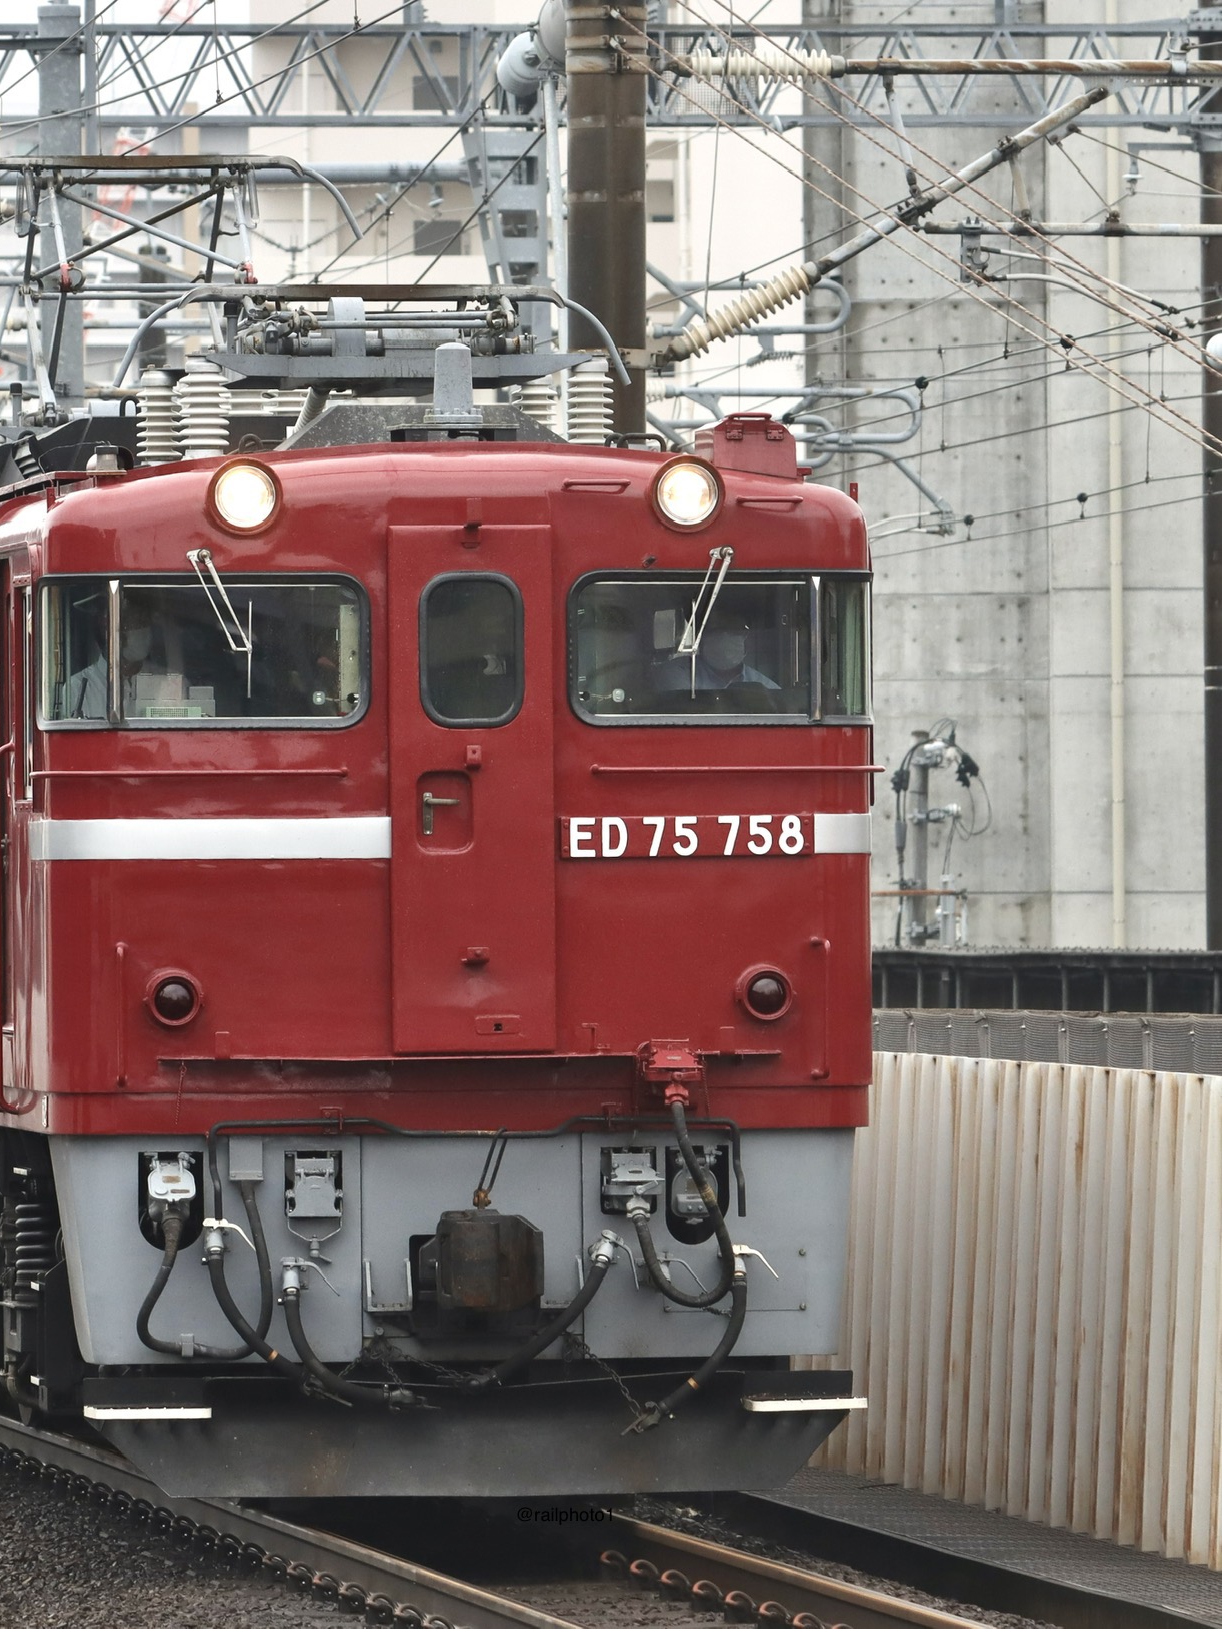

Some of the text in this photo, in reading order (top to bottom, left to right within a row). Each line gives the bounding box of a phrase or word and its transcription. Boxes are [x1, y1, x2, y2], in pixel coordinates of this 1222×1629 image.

[569, 814, 805, 858] ED 75 758
